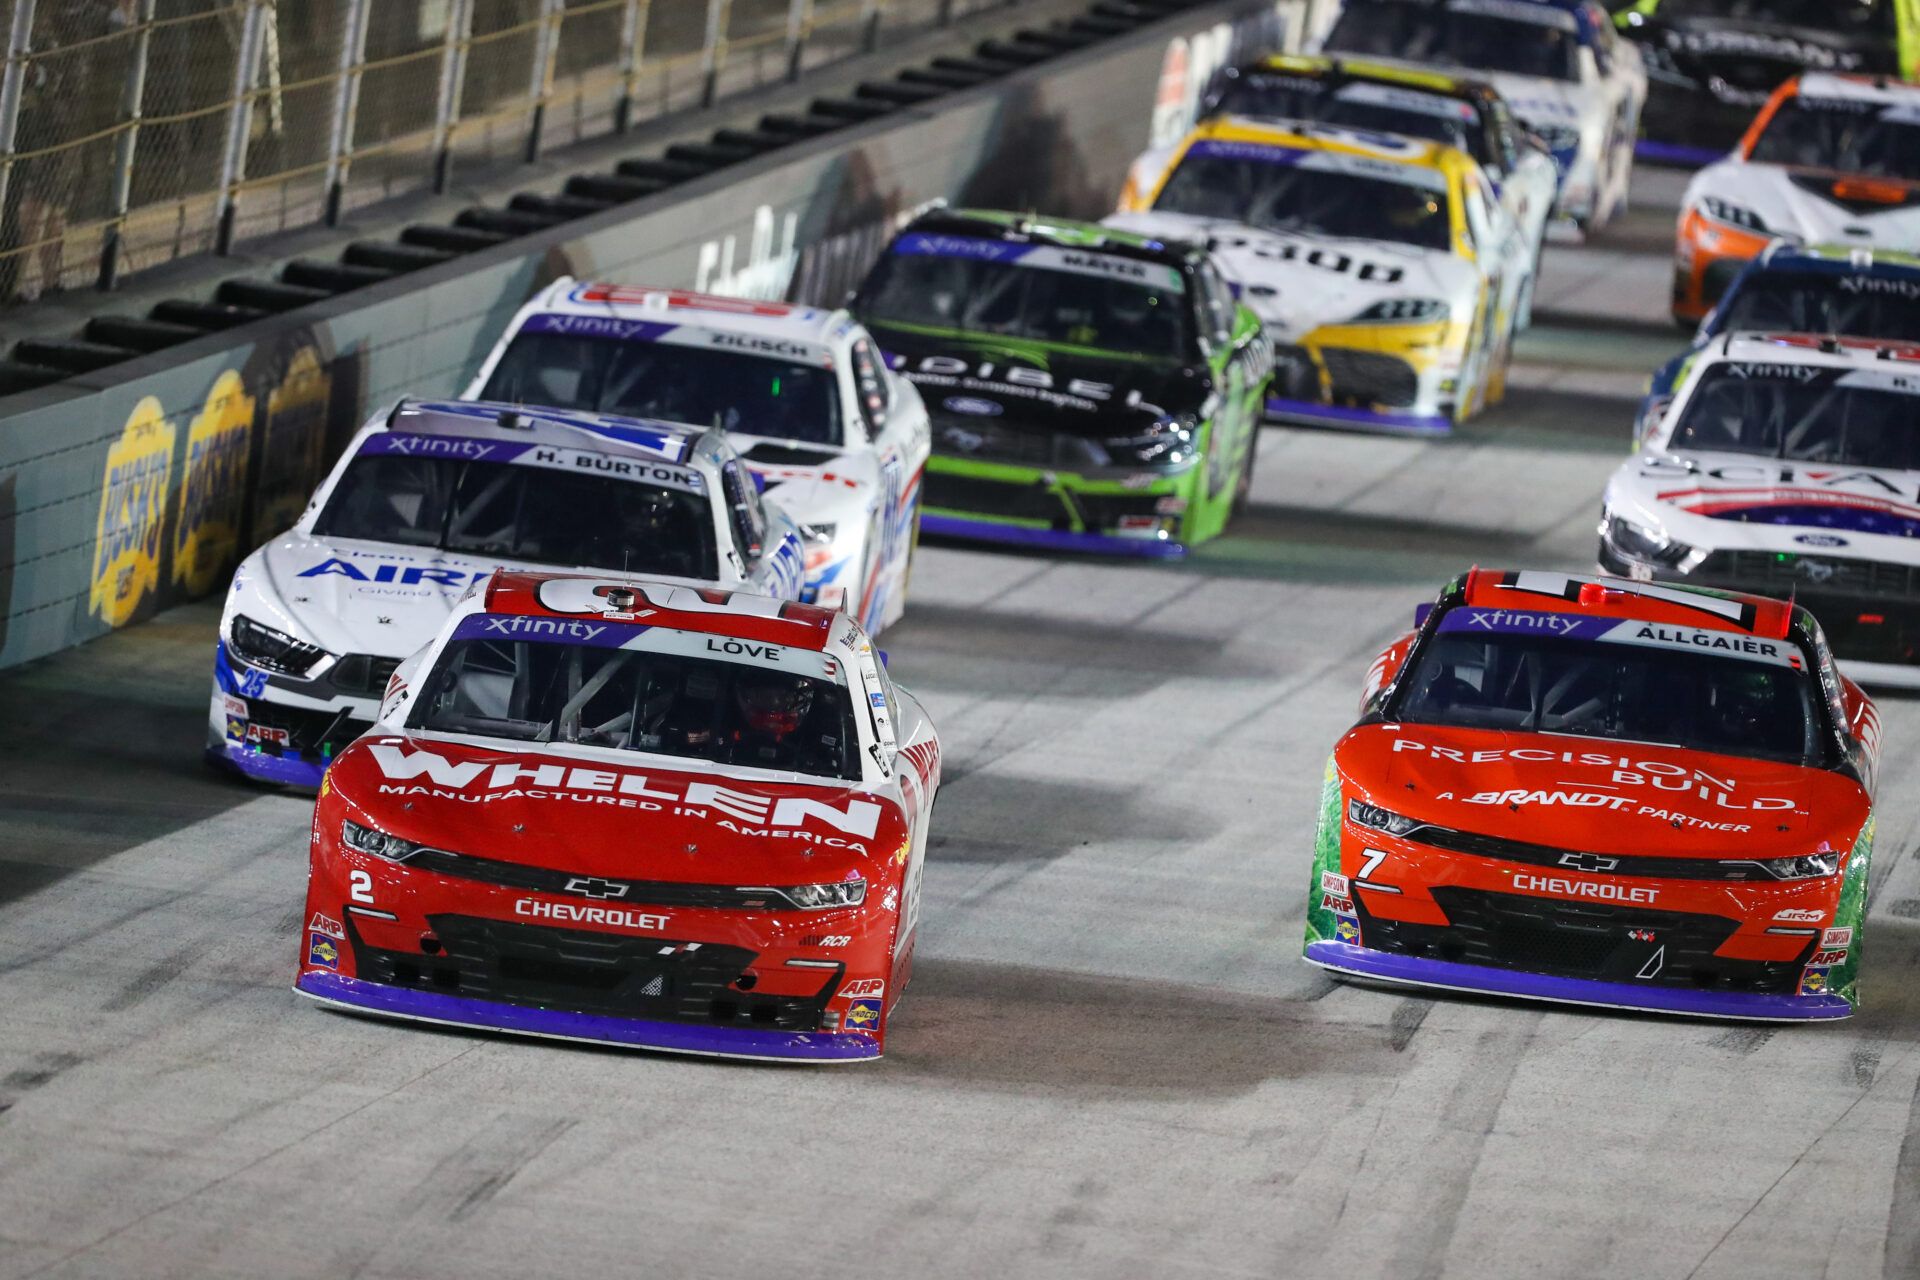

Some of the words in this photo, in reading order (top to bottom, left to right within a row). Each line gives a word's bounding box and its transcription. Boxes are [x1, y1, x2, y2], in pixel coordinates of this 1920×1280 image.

[711, 334, 808, 357] ZILISCH
[387, 437, 495, 460] xfinity
[536, 450, 565, 466] H.
[575, 456, 692, 485] BURTON
[485, 615, 607, 641] xfinity
[1468, 608, 1583, 635] xfinity
[706, 638, 781, 661] LOVE
[1635, 626, 1778, 658] ALLGAIER
[239, 667, 270, 699] 25
[1393, 738, 1737, 791] PRECISION
[366, 744, 883, 841] WHELEN
[1611, 769, 1796, 811] BUILD
[378, 784, 663, 811] MANUFACTURED
[673, 806, 708, 819] IN
[716, 820, 869, 857] AMERICA
[1436, 791, 1454, 801] A
[1636, 805, 1752, 834] PARTNER
[1357, 847, 1389, 880] 7
[350, 869, 375, 904] 2
[1322, 873, 1346, 893] SIMPSON
[1512, 874, 1660, 904] CHEVROLET
[515, 899, 671, 931] CHEVROLET
[1322, 893, 1354, 913] ARP
[312, 914, 344, 936] ARP
[1776, 912, 1820, 922] JRM
[818, 935, 852, 947] RCR
[1824, 929, 1850, 945] SIMPSON
[313, 945, 338, 960] SUNOCO
[1808, 949, 1848, 966] ARP
[844, 979, 883, 995] ARP
[847, 1008, 879, 1021] SUNOCO
